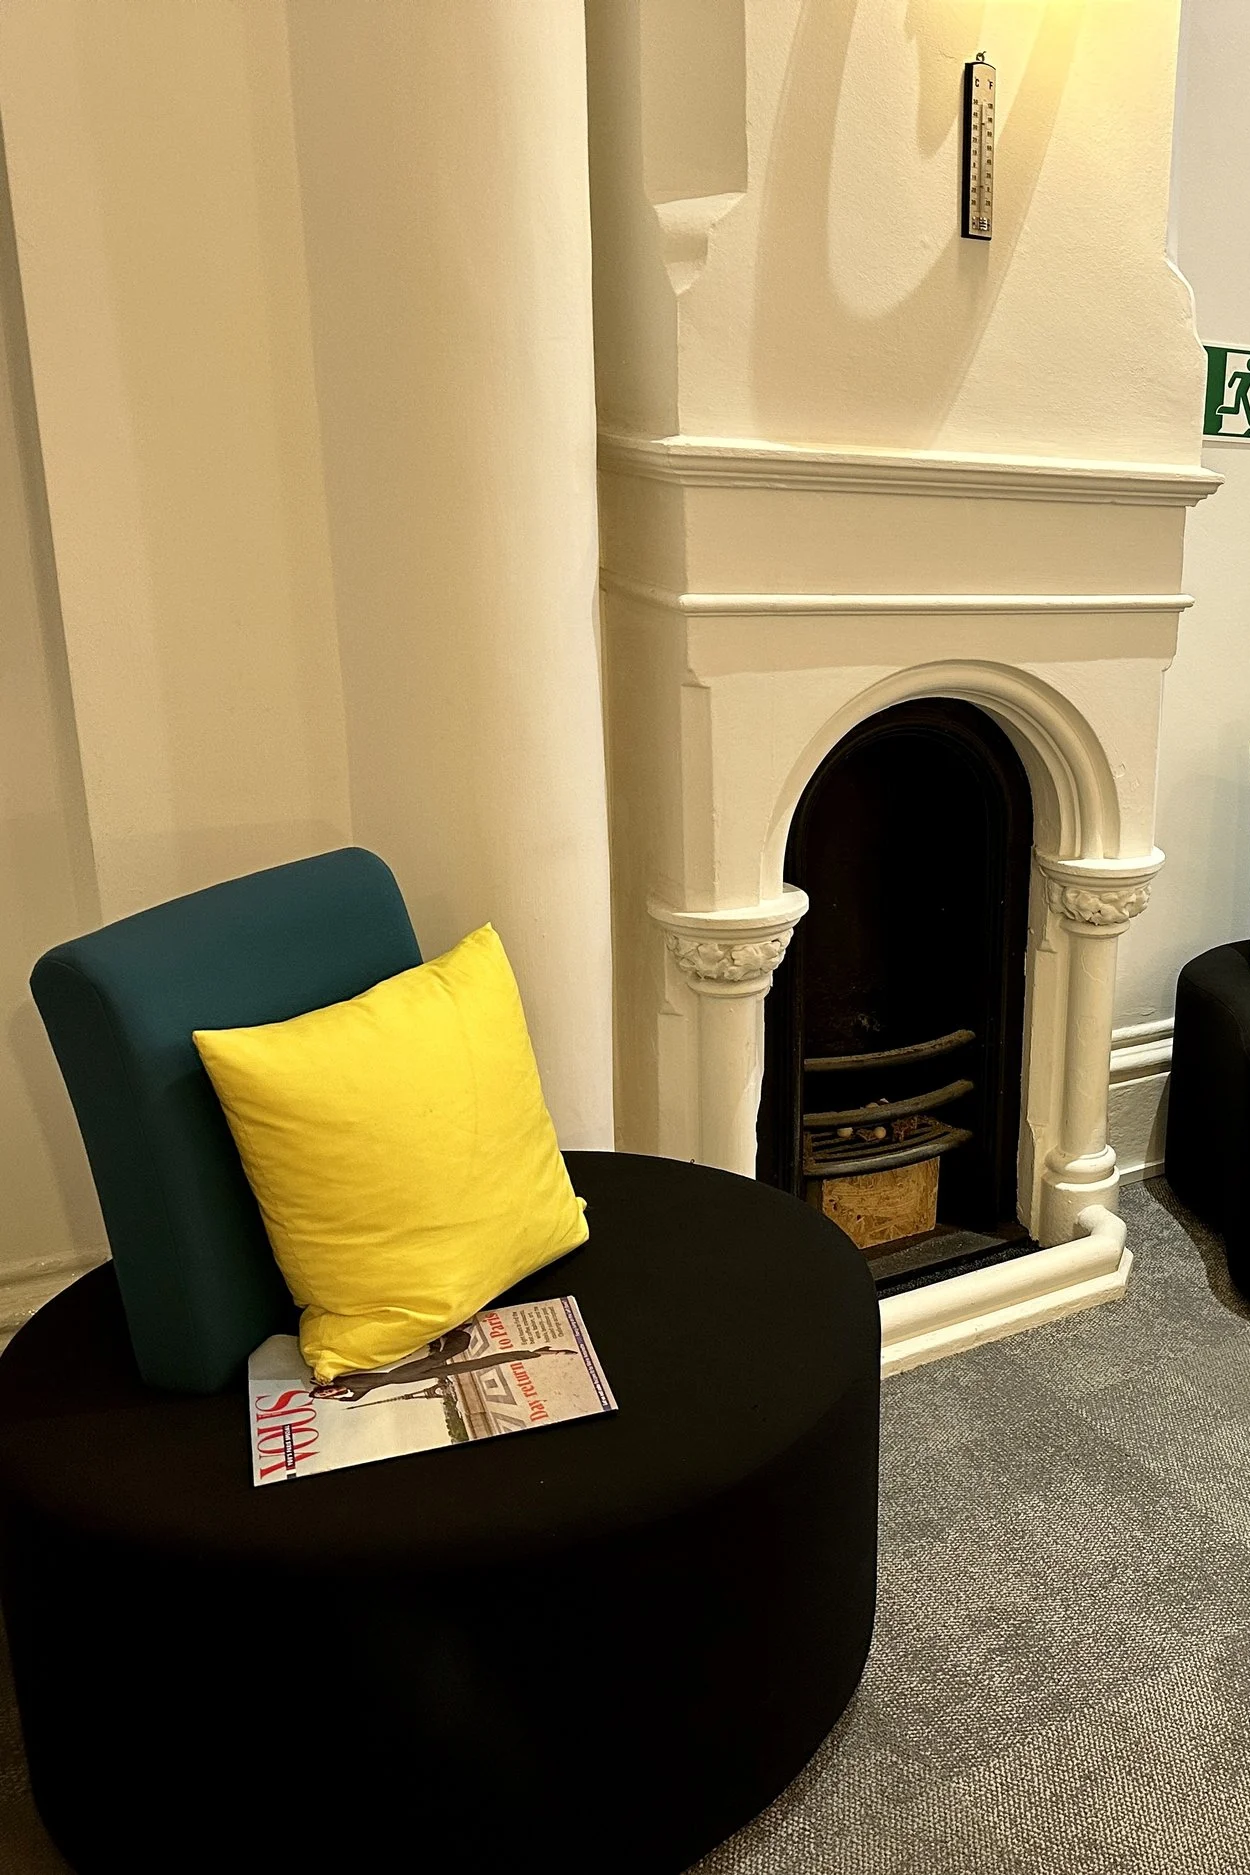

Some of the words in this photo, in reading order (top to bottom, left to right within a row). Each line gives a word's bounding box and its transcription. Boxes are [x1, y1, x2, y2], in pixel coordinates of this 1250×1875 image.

[484, 1312, 507, 1338] Paris
[498, 1338, 513, 1350] to
[510, 1362, 537, 1397] return
[528, 1399, 549, 1422] Day
[255, 1390, 320, 1480] VOUS
